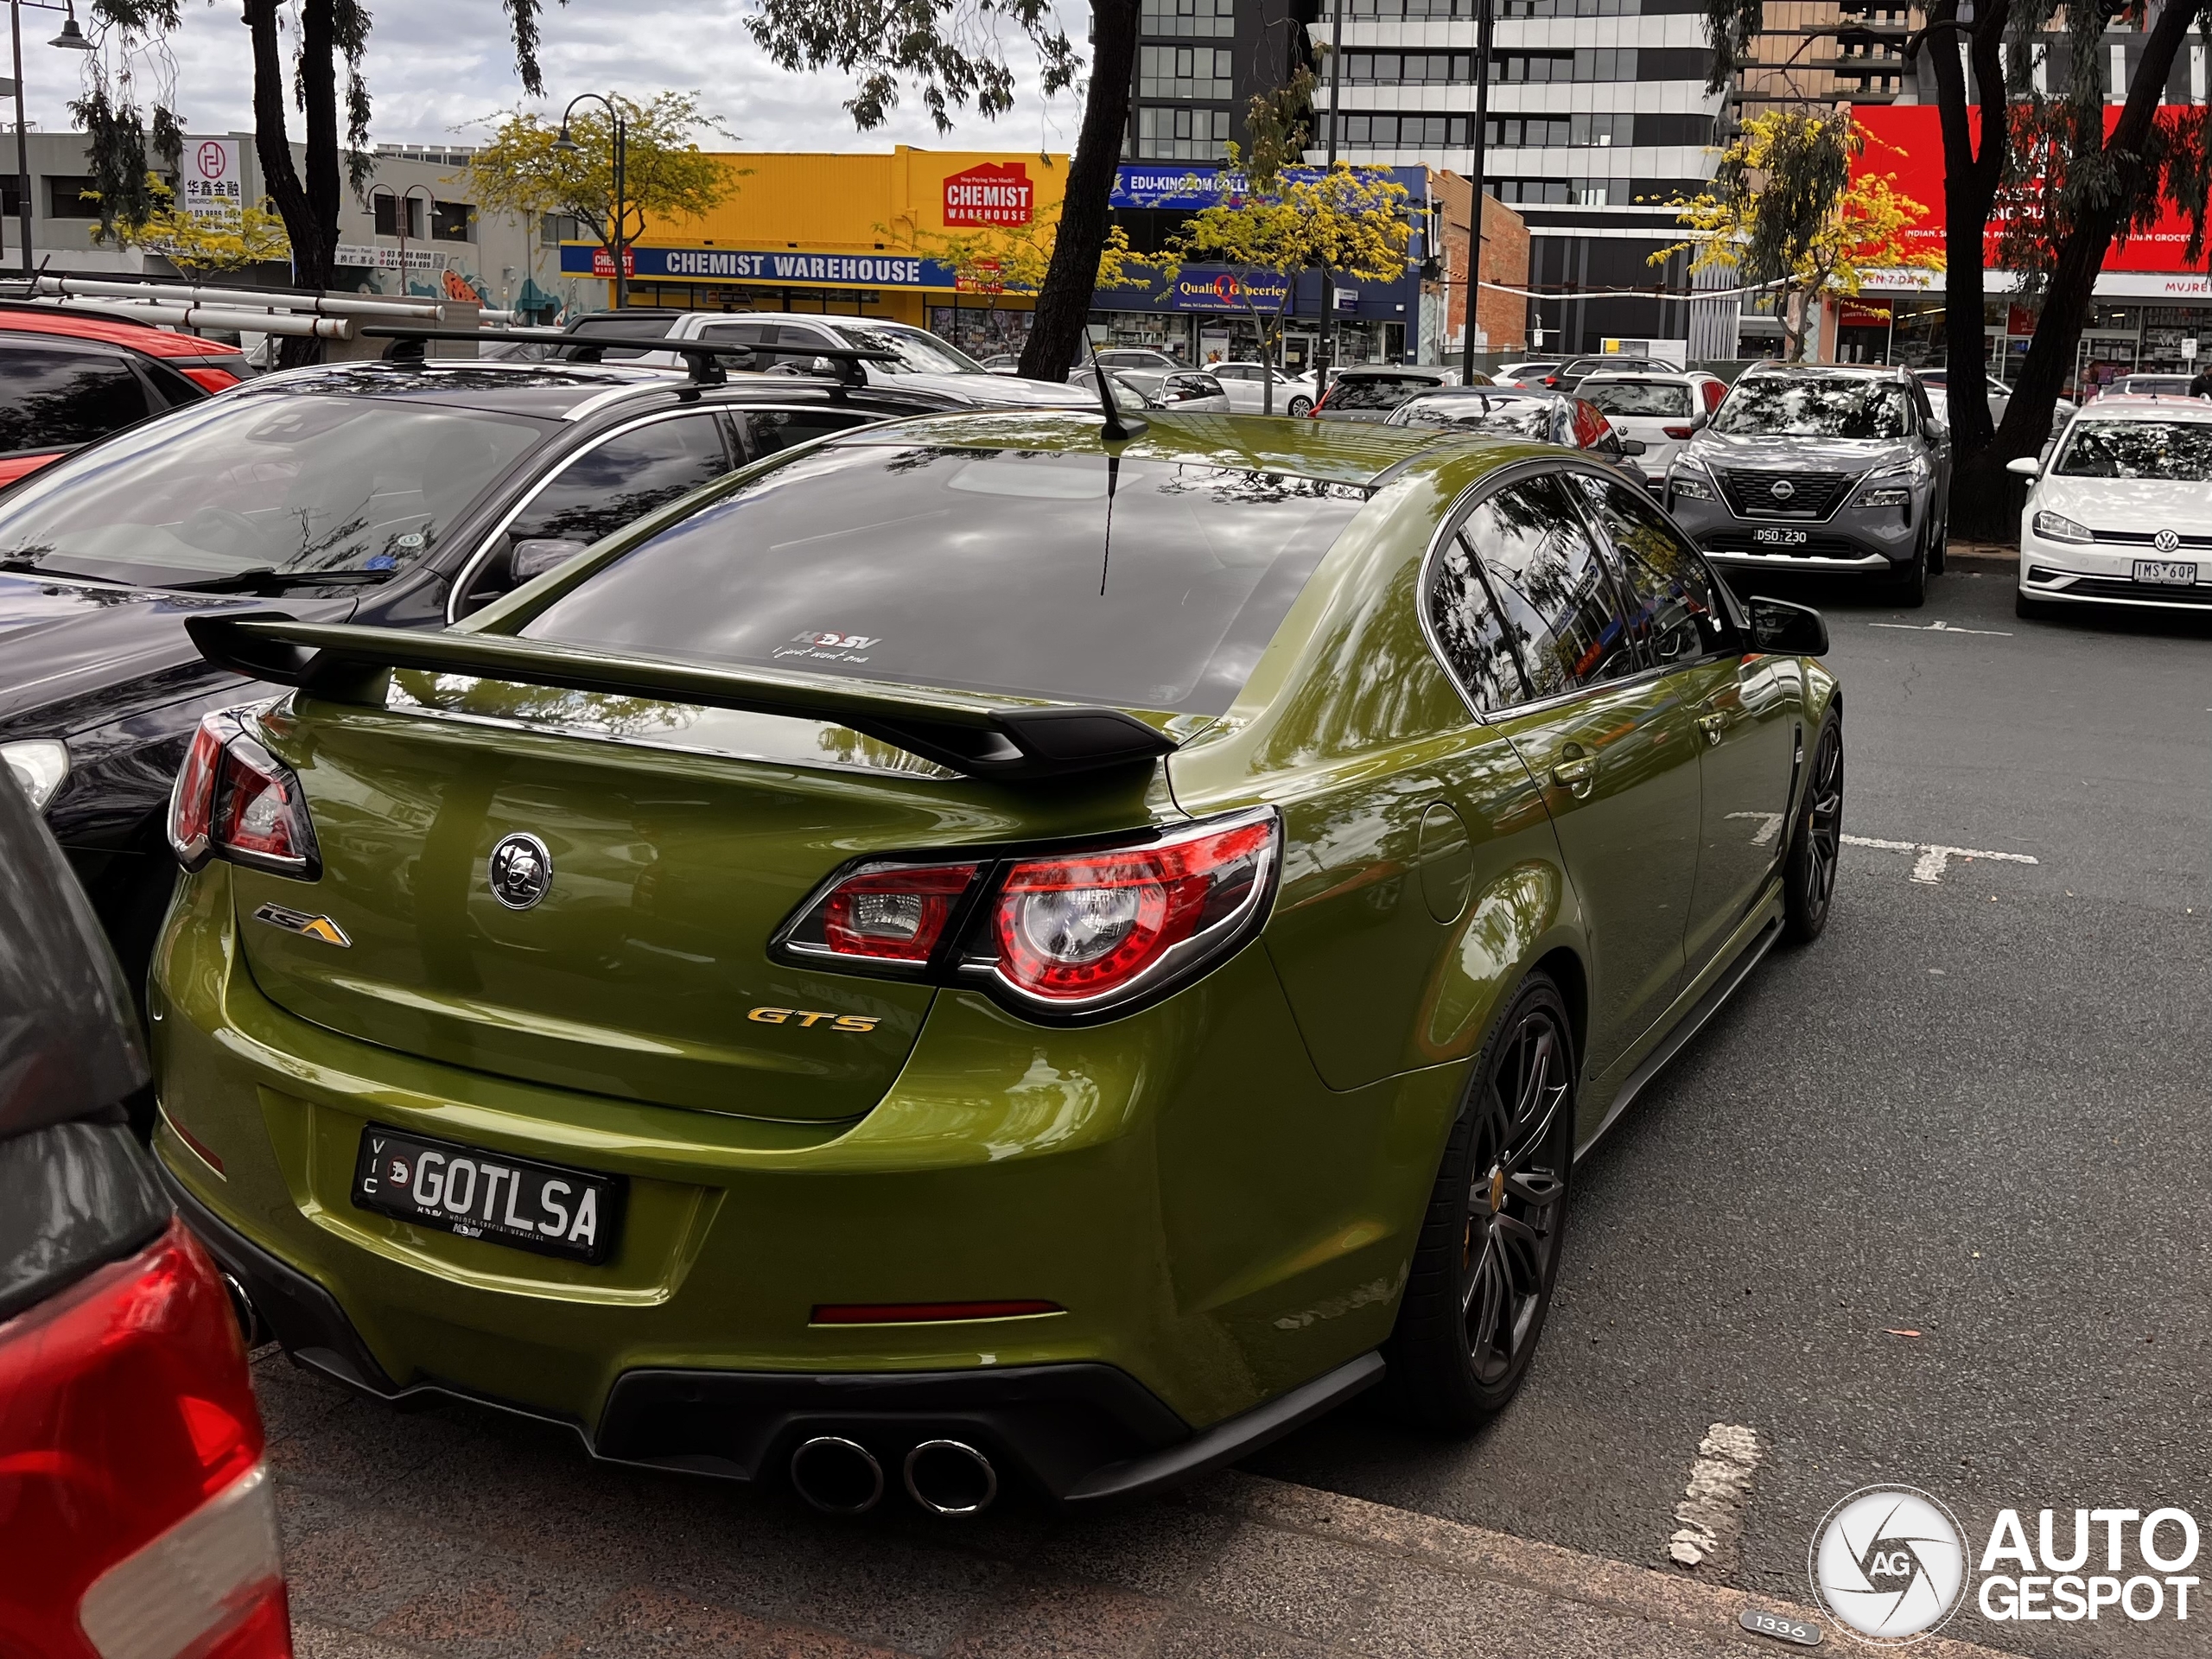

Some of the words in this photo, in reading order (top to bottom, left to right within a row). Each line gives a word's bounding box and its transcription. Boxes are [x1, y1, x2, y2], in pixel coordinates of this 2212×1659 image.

[187, 180, 239, 197] 华鑫金融
[947, 185, 1029, 207] CHEMIST
[947, 208, 1027, 220] WAREHOUSE
[1904, 229, 1937, 238] INDIAN,
[387, 250, 395, 258] 03
[397, 251, 414, 259] 986
[594, 255, 632, 267] CHEST
[666, 251, 765, 276] CHEMIST
[773, 256, 920, 283] WAREHOUSE
[1899, 276, 1927, 285] DAY
[1179, 282, 1224, 296] Quality
[1230, 283, 1287, 297] Goceries
[1784, 531, 1807, 543] 230
[774, 646, 816, 658] just
[810, 650, 849, 660] want
[842, 655, 869, 664] one
[747, 1007, 882, 1033] GTS
[412, 1151, 597, 1247] GOTLSA
[1754, 1613, 1808, 1639] 1336
